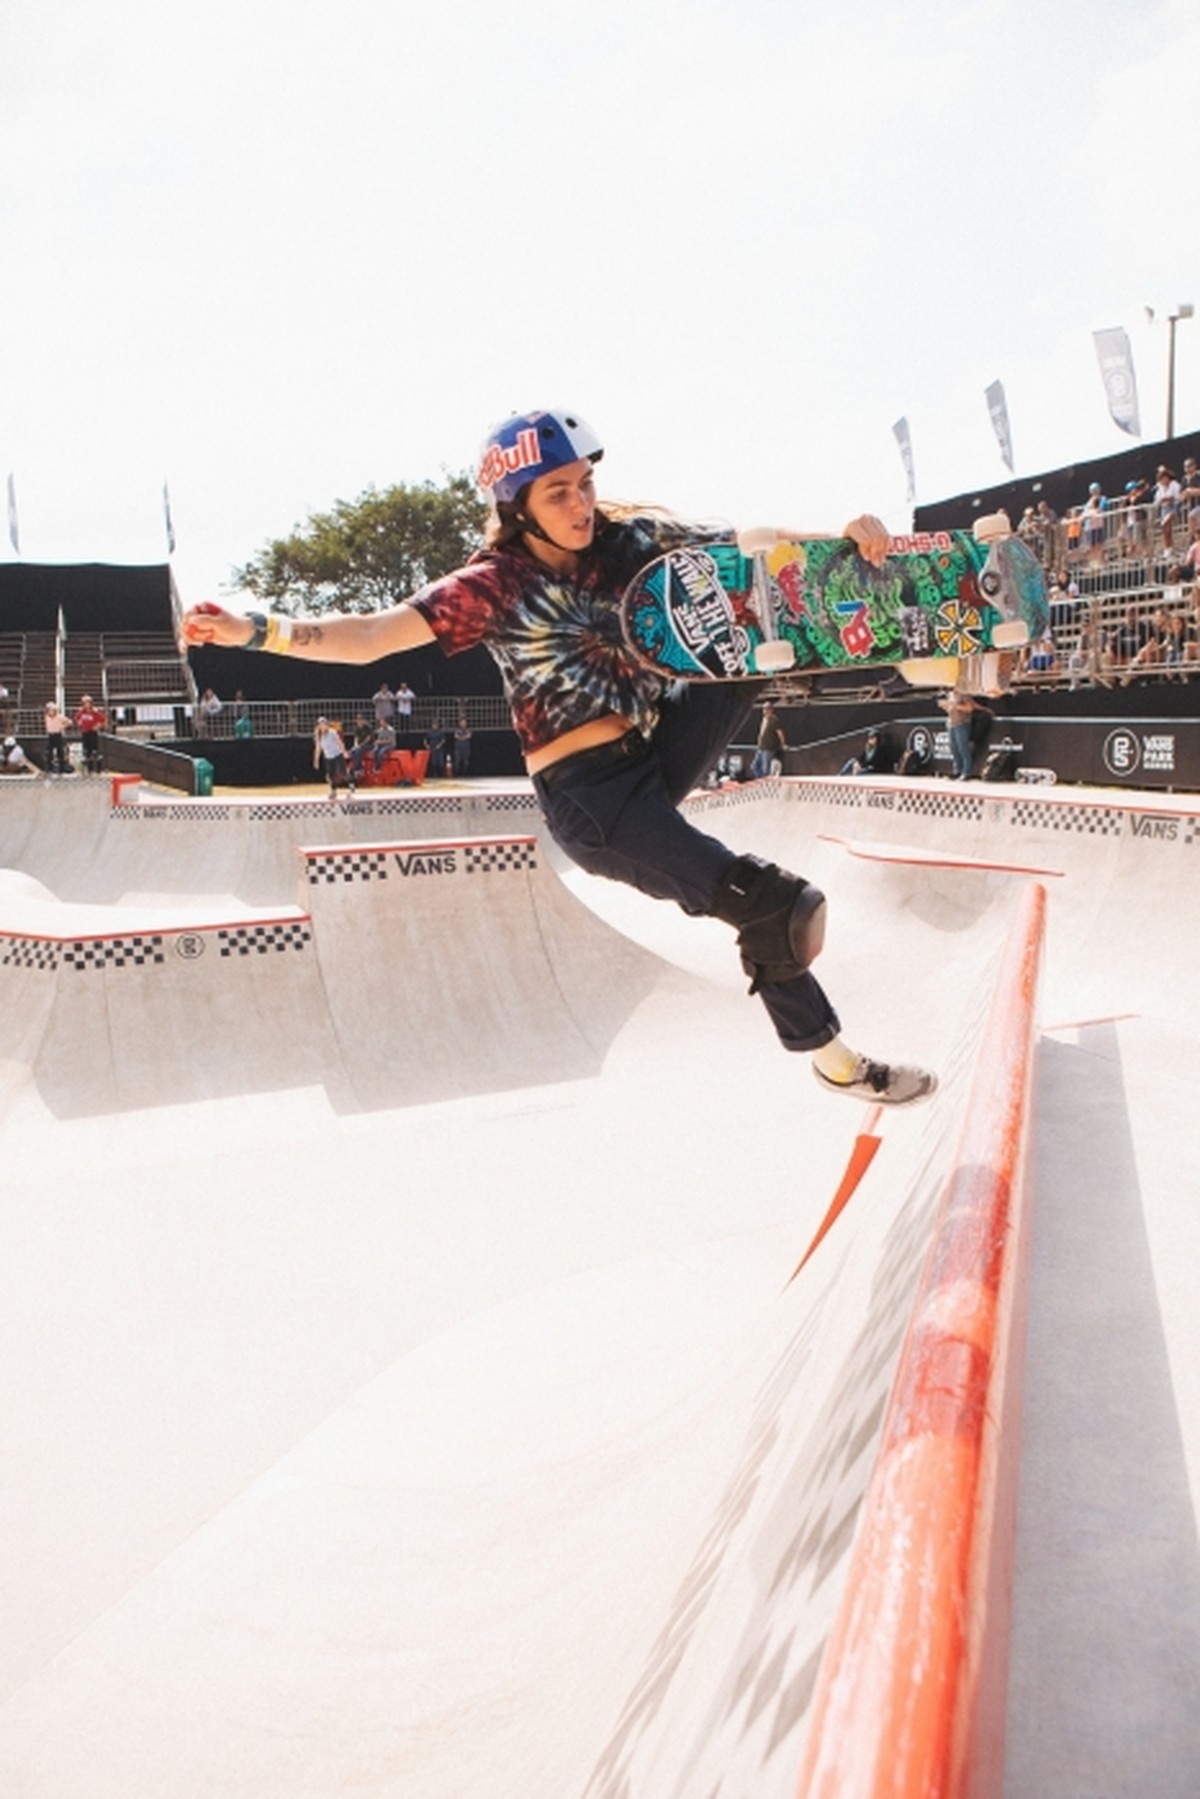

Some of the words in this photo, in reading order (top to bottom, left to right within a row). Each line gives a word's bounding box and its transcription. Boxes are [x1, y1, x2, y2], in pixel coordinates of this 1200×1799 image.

[672, 602, 711, 655] VANS
[696, 596, 729, 641] THE
[339, 801, 374, 816] VANS
[1129, 813, 1181, 841] VANS
[394, 850, 457, 877] VANS
